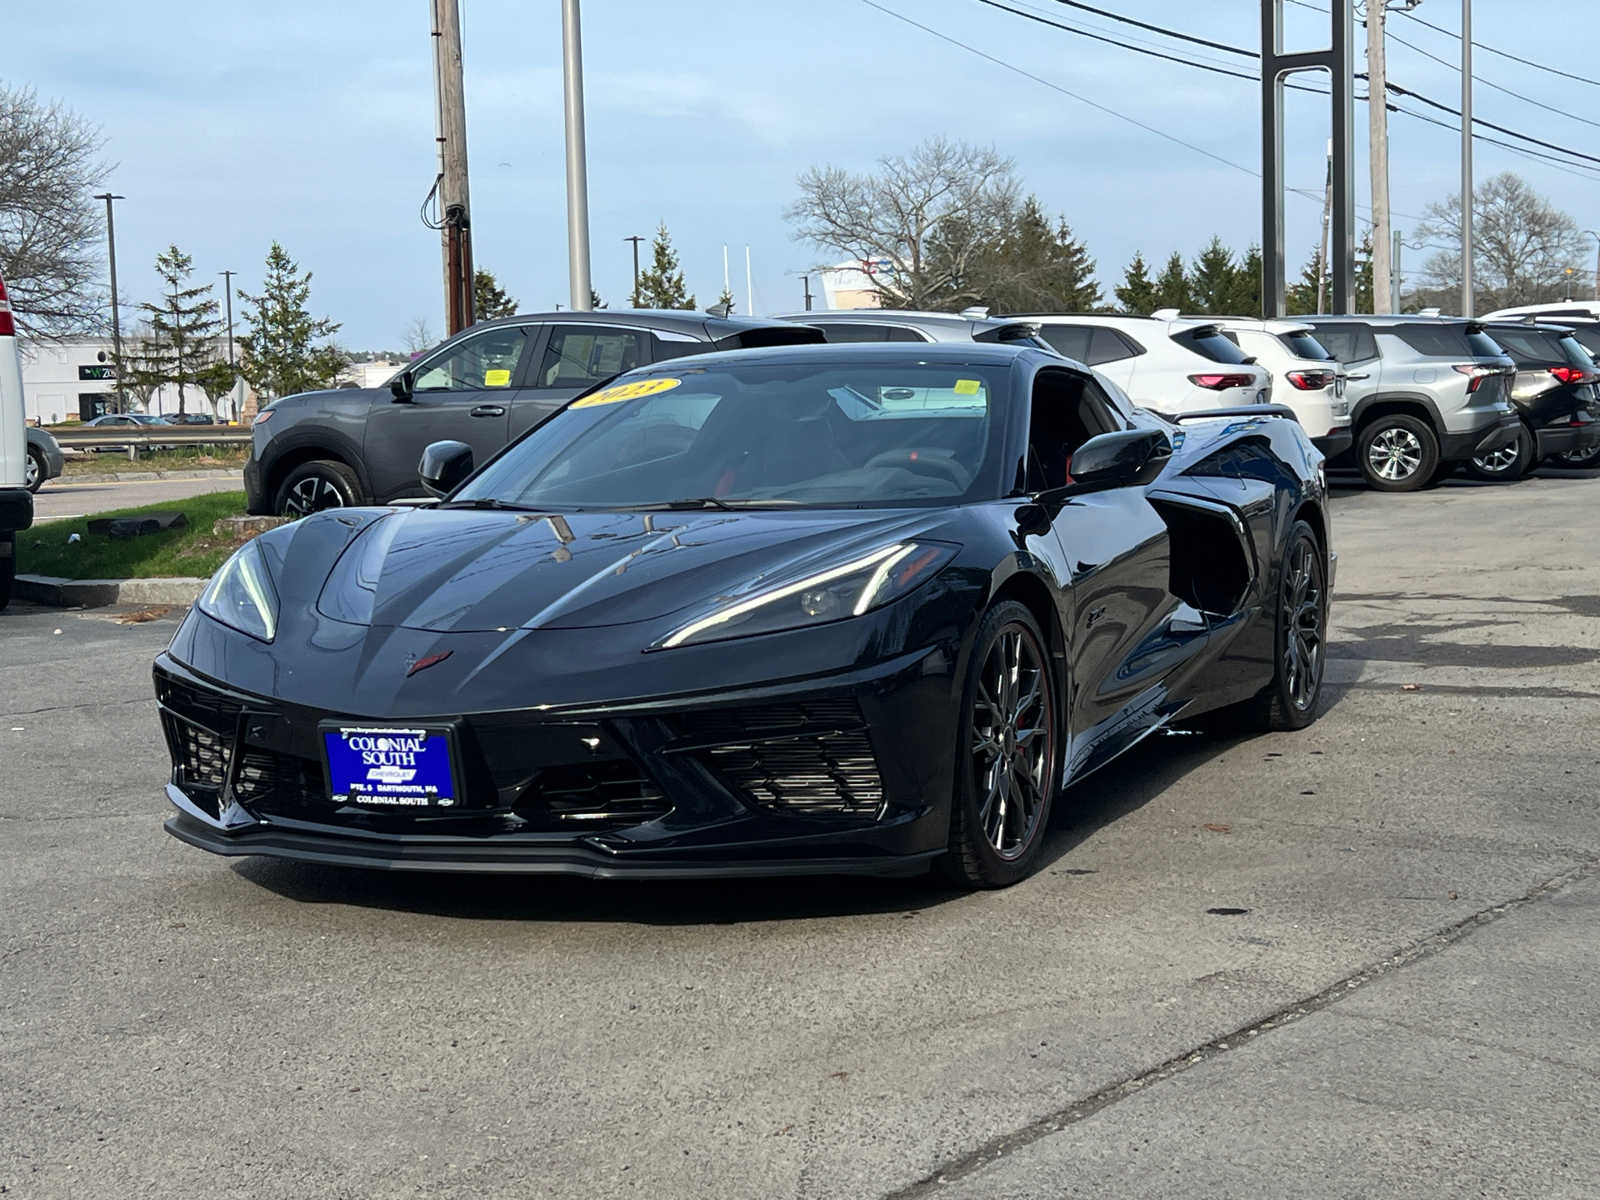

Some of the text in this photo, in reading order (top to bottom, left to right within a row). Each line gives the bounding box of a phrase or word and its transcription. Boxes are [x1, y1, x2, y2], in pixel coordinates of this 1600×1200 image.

[349, 737, 426, 752] COLONIAL
[362, 752, 416, 765] SOUTH
[371, 770, 411, 778] CHEVROLET
[356, 795, 429, 805] COLONIAL SOUTH
